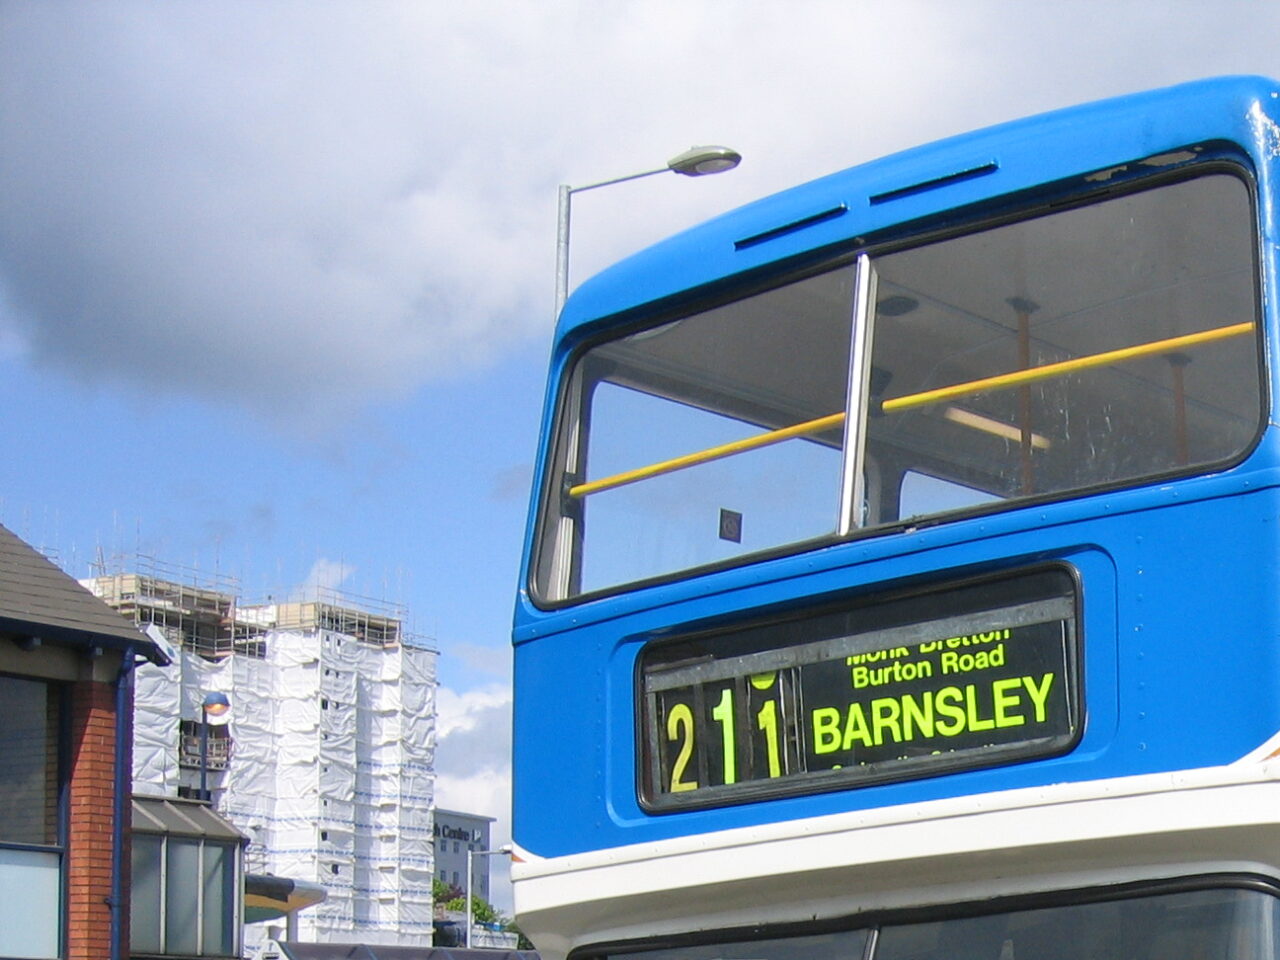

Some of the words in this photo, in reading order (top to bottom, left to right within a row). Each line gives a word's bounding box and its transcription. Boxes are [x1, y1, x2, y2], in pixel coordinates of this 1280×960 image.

[852, 660, 932, 689] Burton
[941, 643, 1005, 675] Road
[812, 672, 1055, 755] BARNSLEY
